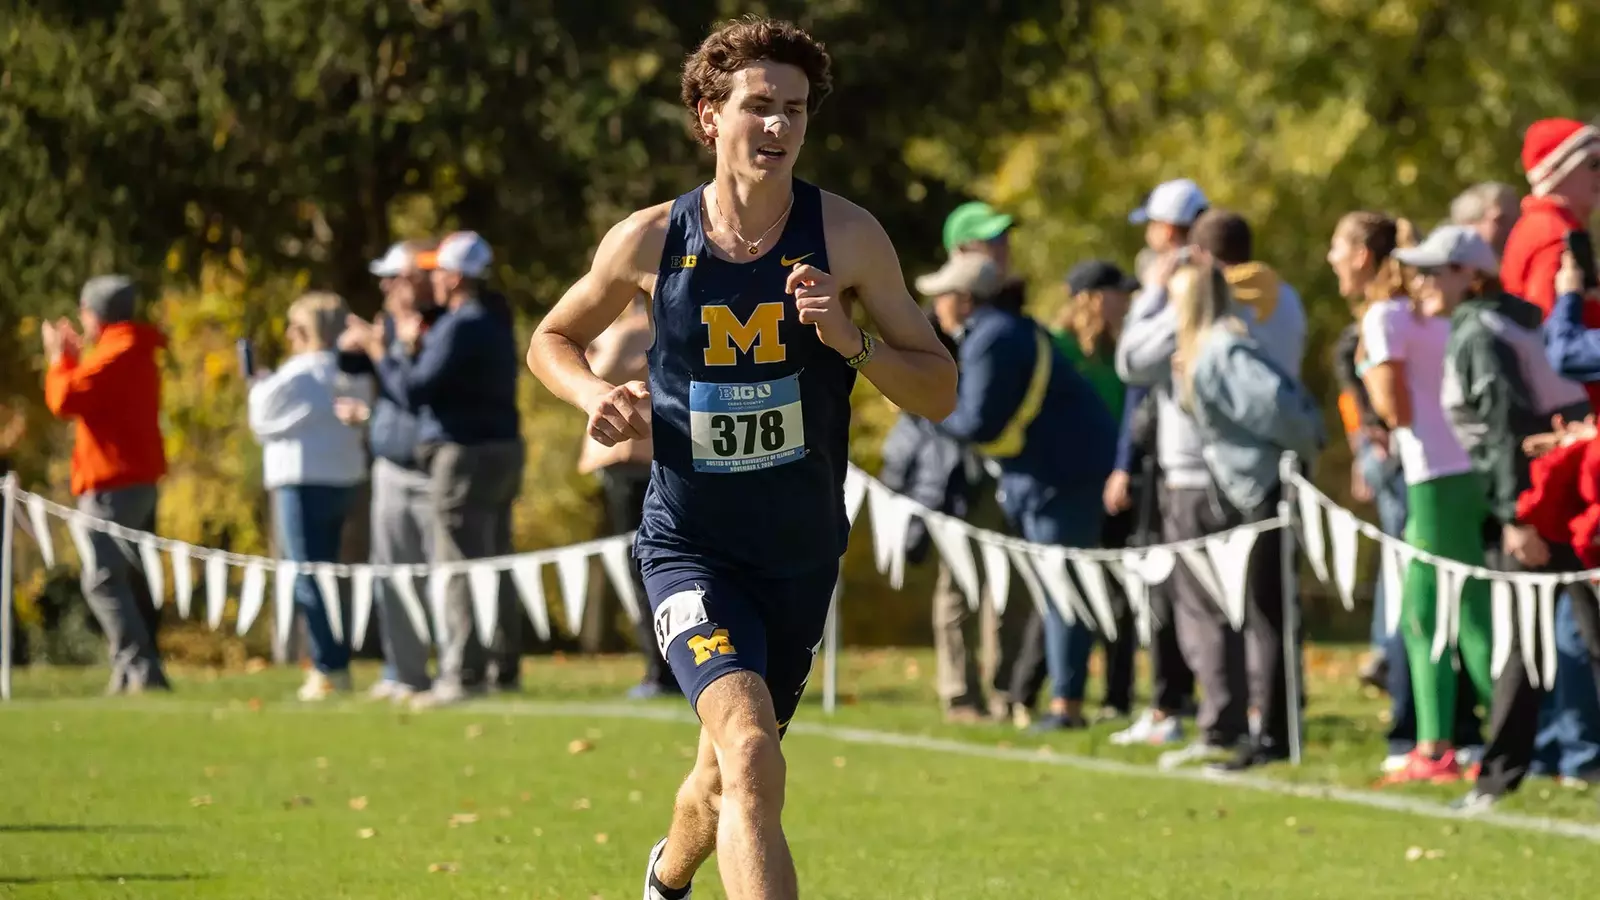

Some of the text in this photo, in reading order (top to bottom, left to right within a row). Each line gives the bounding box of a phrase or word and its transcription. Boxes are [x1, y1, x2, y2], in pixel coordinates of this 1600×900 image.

[701, 302, 786, 366] M
[711, 410, 785, 457] 378
[730, 464, 756, 472] NOVEMBER
[741, 457, 770, 465] UNIVERSITY
[777, 450, 795, 458] ILLINOIS
[686, 628, 737, 666] M
